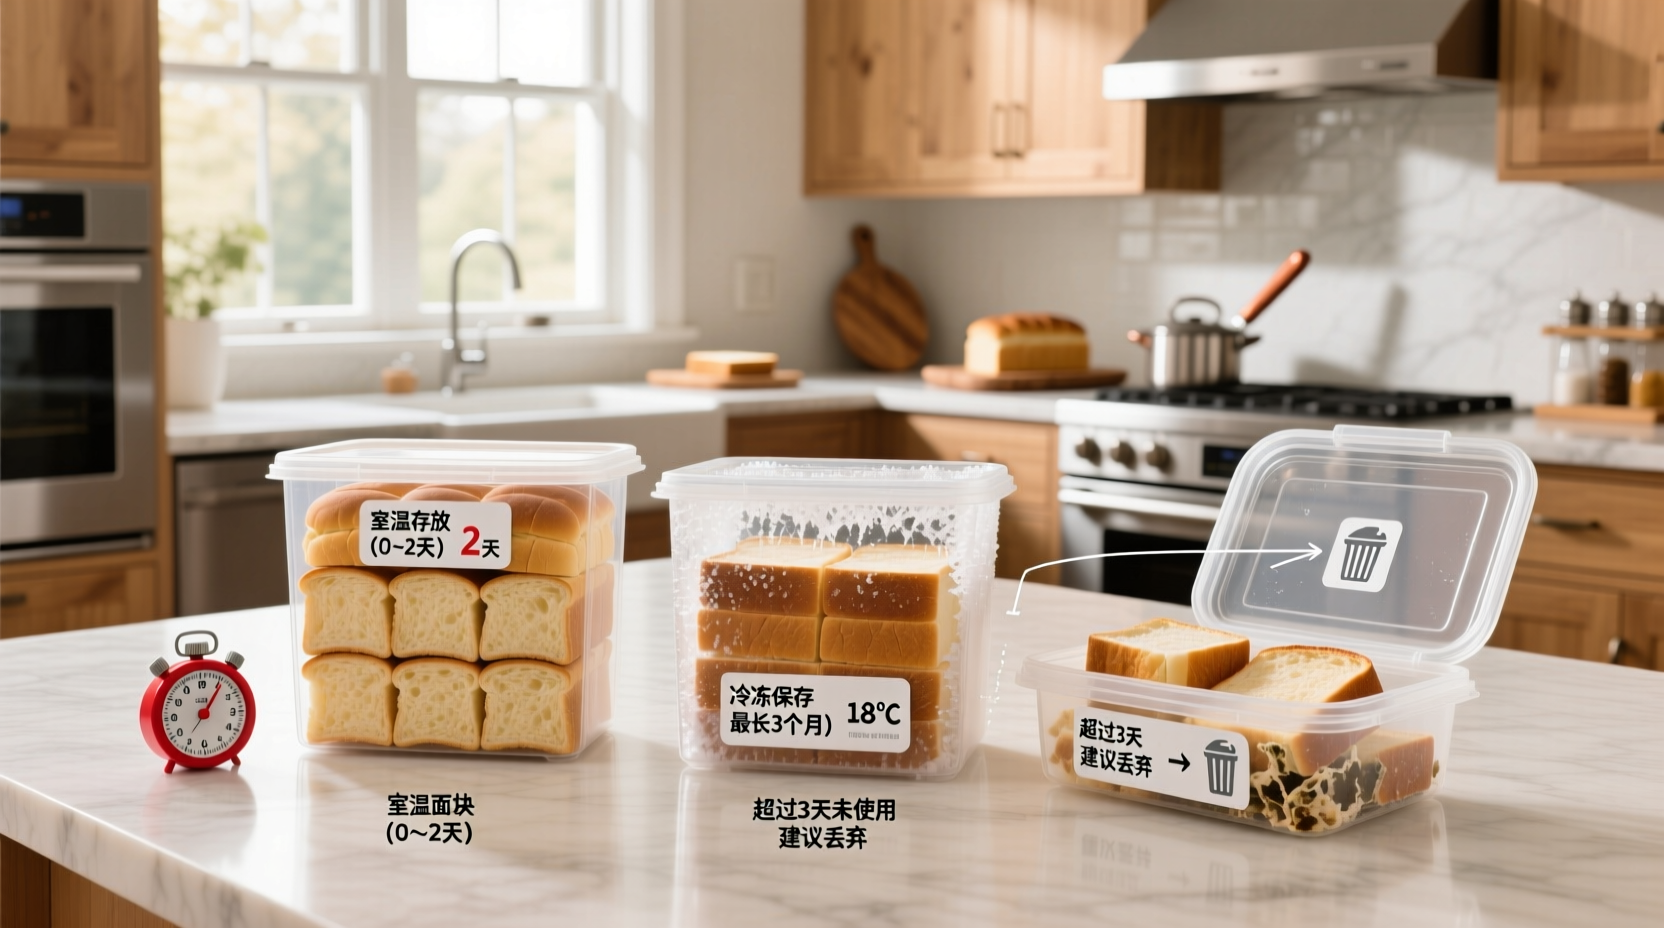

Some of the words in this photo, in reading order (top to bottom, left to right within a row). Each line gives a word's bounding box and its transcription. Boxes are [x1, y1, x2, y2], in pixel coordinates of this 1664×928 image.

[371, 509, 451, 532] 室温存放
[370, 536, 444, 559] (0~2天)
[729, 683, 815, 708] 冷冻保存
[730, 711, 832, 737] 最长3个月)
[847, 701, 901, 725] 18°C
[1079, 717, 1142, 748] 超过3天
[1080, 745, 1152, 778] 建议丢弃
